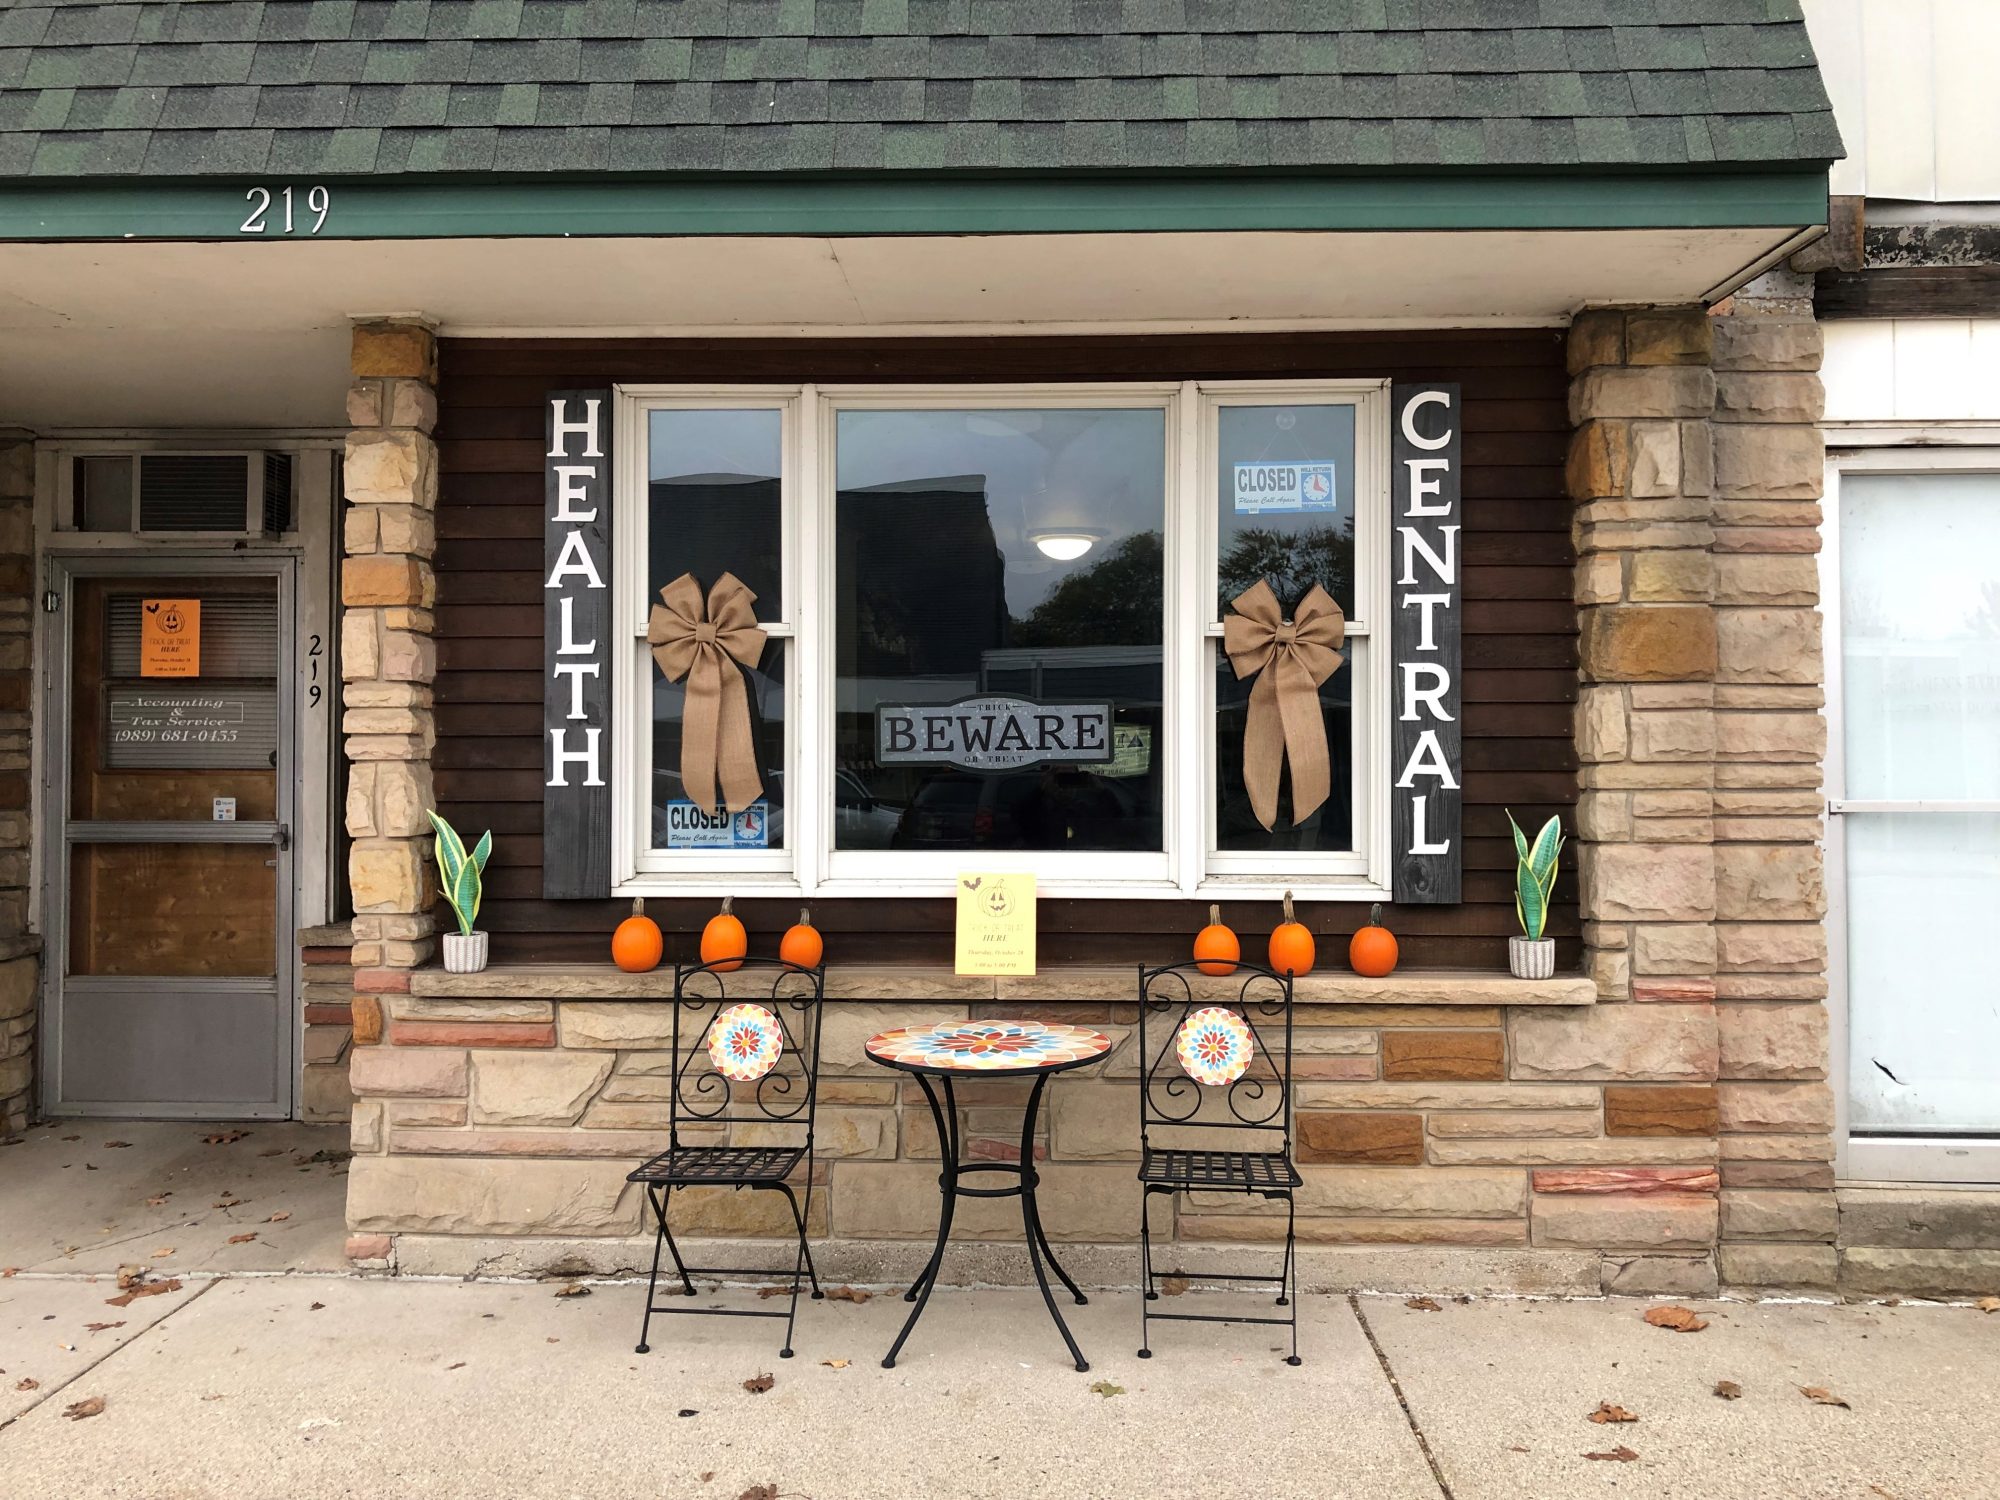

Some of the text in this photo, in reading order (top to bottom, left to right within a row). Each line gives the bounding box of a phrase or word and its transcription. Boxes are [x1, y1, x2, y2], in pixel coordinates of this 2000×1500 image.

[240, 185, 330, 234] 219
[1238, 467, 1297, 493] CLOSED
[1238, 495, 1296, 504] Please Call Again
[545, 399, 606, 788] HEALTH
[1394, 390, 1461, 857] CENTRAL
[309, 634, 323, 709] 219
[129, 697, 224, 709] Accounting
[977, 703, 1011, 711] TRICK
[170, 707, 185, 717] &
[131, 716, 227, 726] Tax Service
[115, 729, 156, 742] (989)
[885, 713, 1105, 753] BEWARE
[964, 755, 1024, 763] OR TREAT
[671, 806, 730, 830] CLOSED
[693, 833, 707, 842] Call
[708, 834, 728, 842] Again
